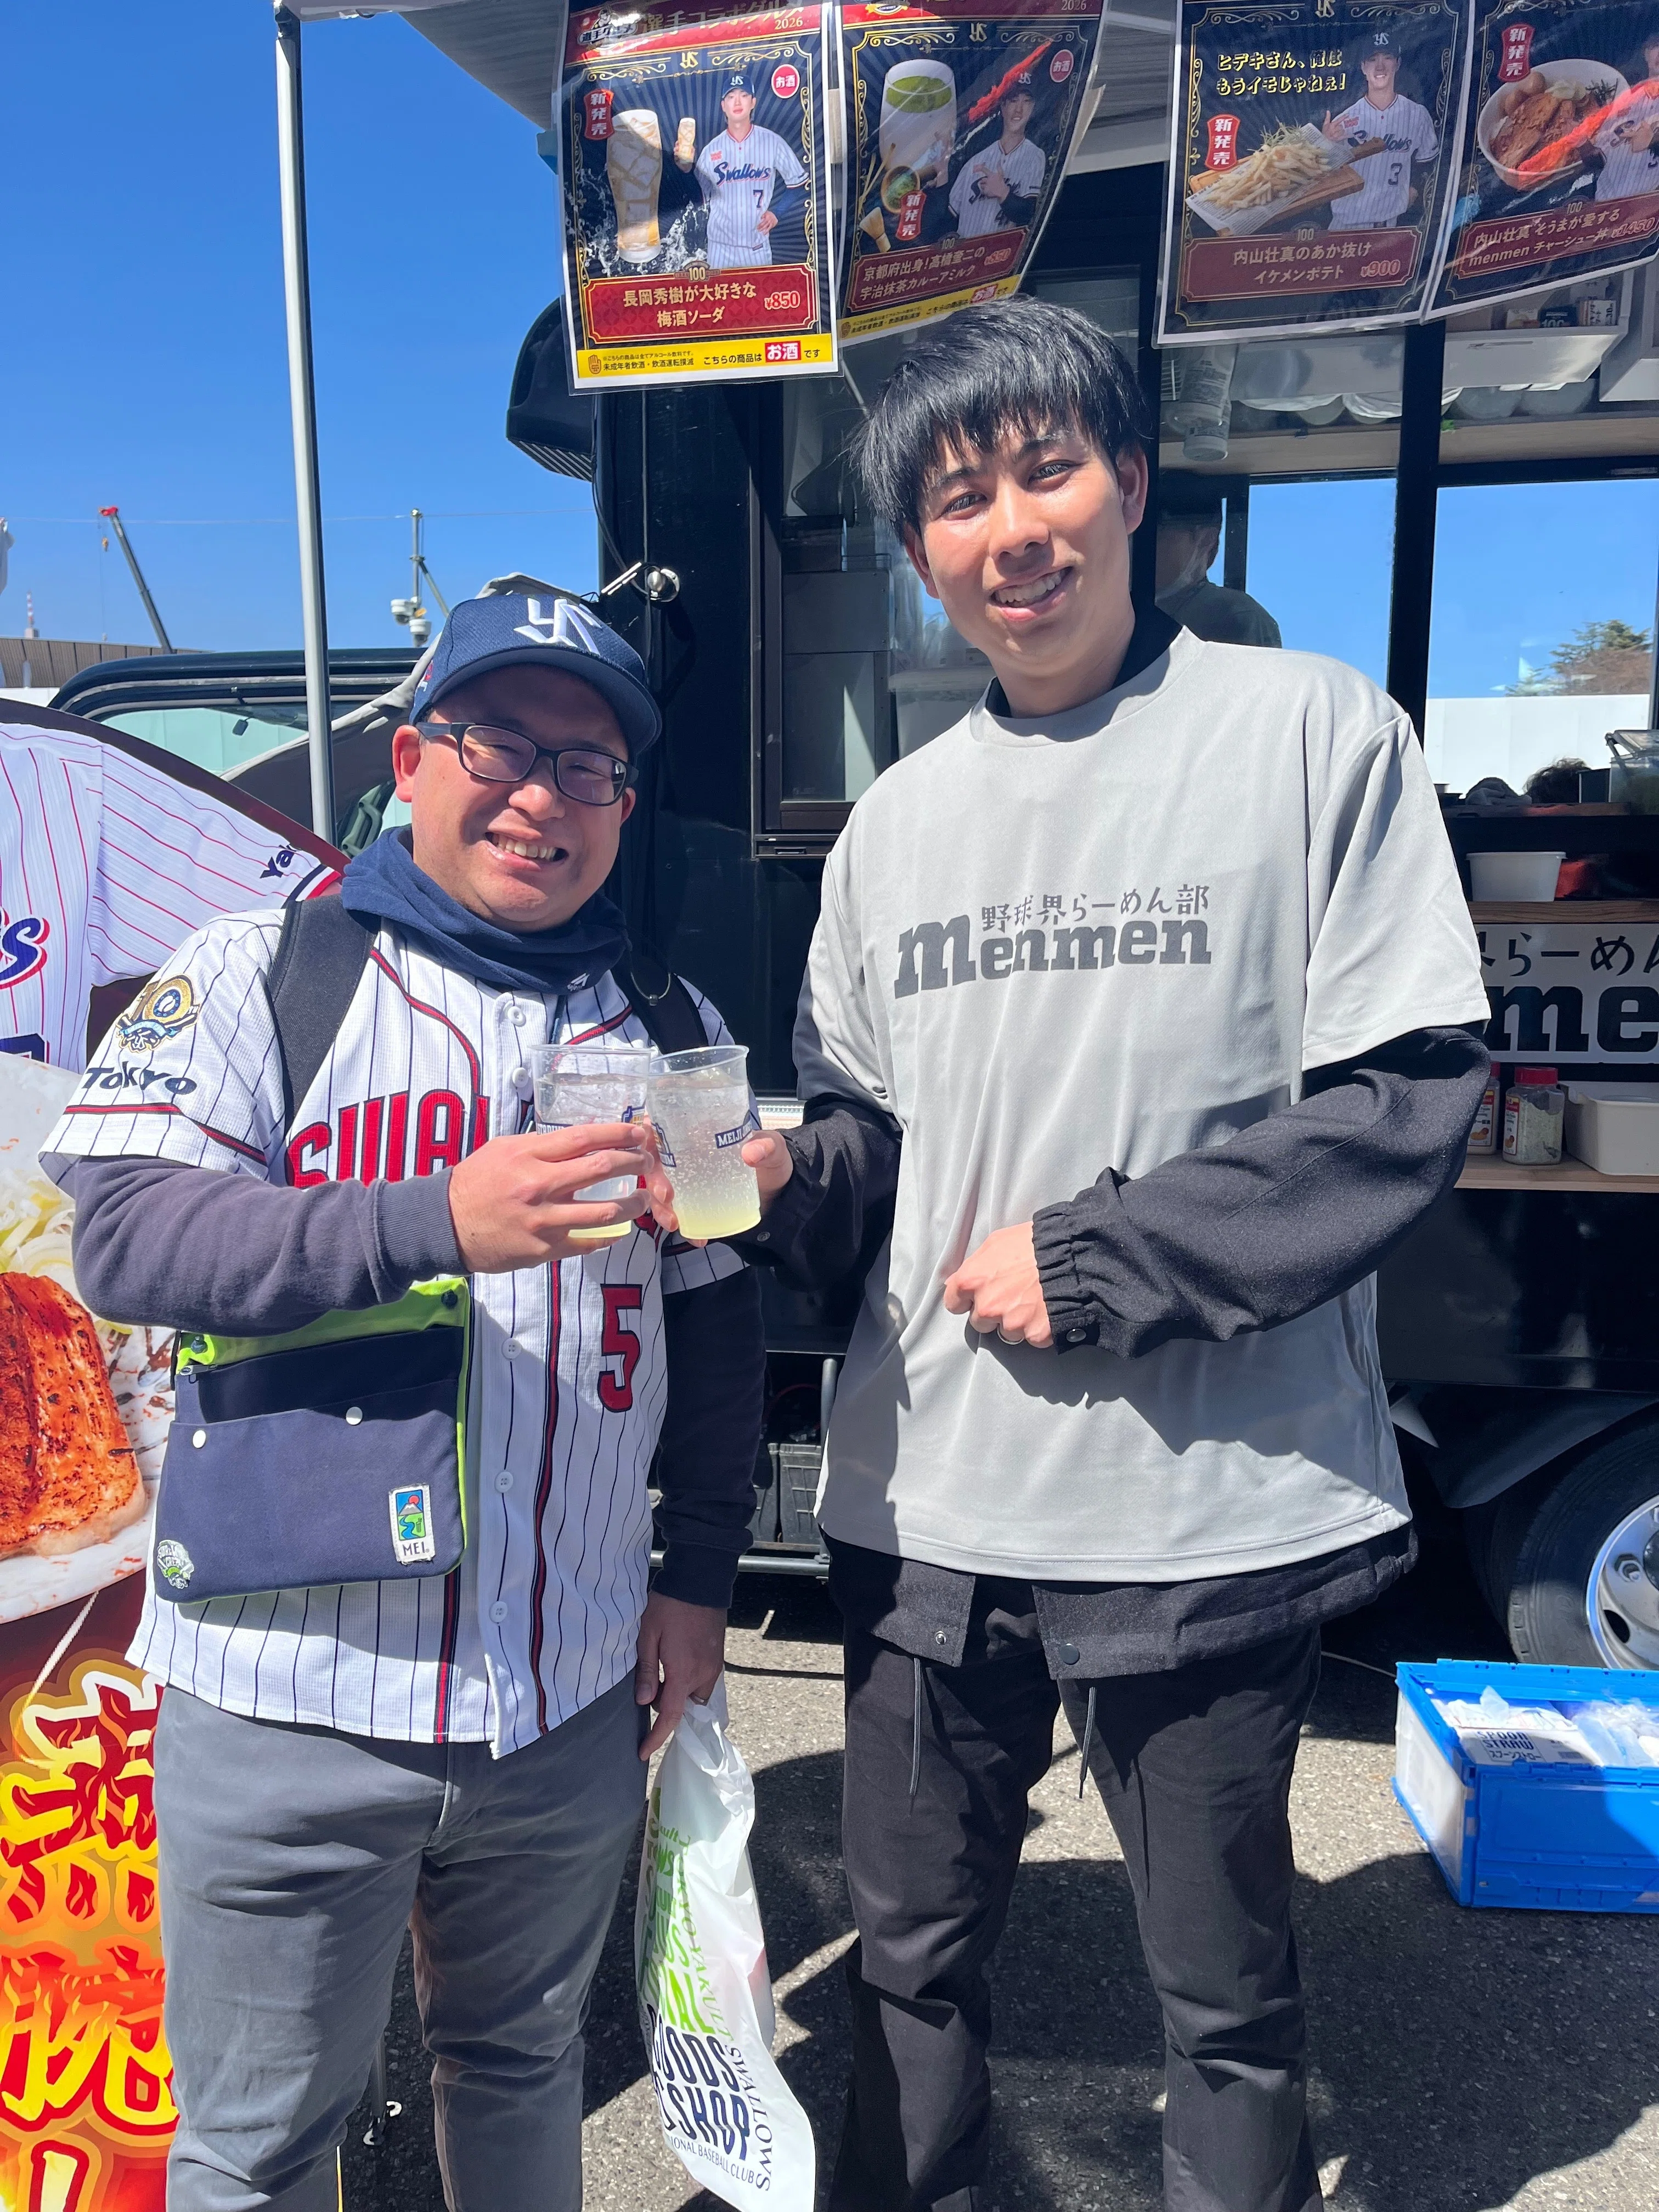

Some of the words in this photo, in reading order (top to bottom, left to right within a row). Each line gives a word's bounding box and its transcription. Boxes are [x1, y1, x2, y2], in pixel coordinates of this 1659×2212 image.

[1061, 0, 1087, 11] 2026
[775, 16, 803, 30] 2026
[1506, 27, 1528, 76] 新発売
[1052, 58, 1071, 73] お酒
[775, 76, 795, 88] お酒
[590, 92, 607, 136] 新発売
[1213, 119, 1233, 166] 新発売
[713, 161, 771, 187] Swallows
[1388, 163, 1402, 185] 3
[753, 189, 764, 208] 7
[1566, 201, 1583, 214] 100
[902, 194, 922, 237] 新発売
[1297, 228, 1314, 241] 100
[1234, 242, 1372, 266] 内山壮真のあか抜け
[1469, 245, 1530, 267] menmen
[1533, 228, 1609, 254] チャーシュー丼
[689, 267, 706, 281] 100
[1255, 265, 1344, 285] イケメンポテト
[1360, 259, 1401, 278] ¥900
[860, 264, 975, 301] 宇治抹茶カルーアミルク
[623, 281, 757, 308] 長岡秀樹が大好きな
[764, 291, 801, 310] ¥850
[657, 306, 725, 328] 梅酒ソーダ
[703, 353, 762, 365] こちらの商品は
[766, 342, 799, 360] お酒
[804, 349, 820, 358] です
[981, 884, 1210, 933] 野球界らーめん部
[597, 1284, 643, 1413] 5
[1482, 1739, 1534, 1750] STRAW
[724, 2044, 773, 2192] SWALLOWS
[698, 2143, 730, 2174] BASEBALL
[730, 2163, 754, 2185] CLUB
